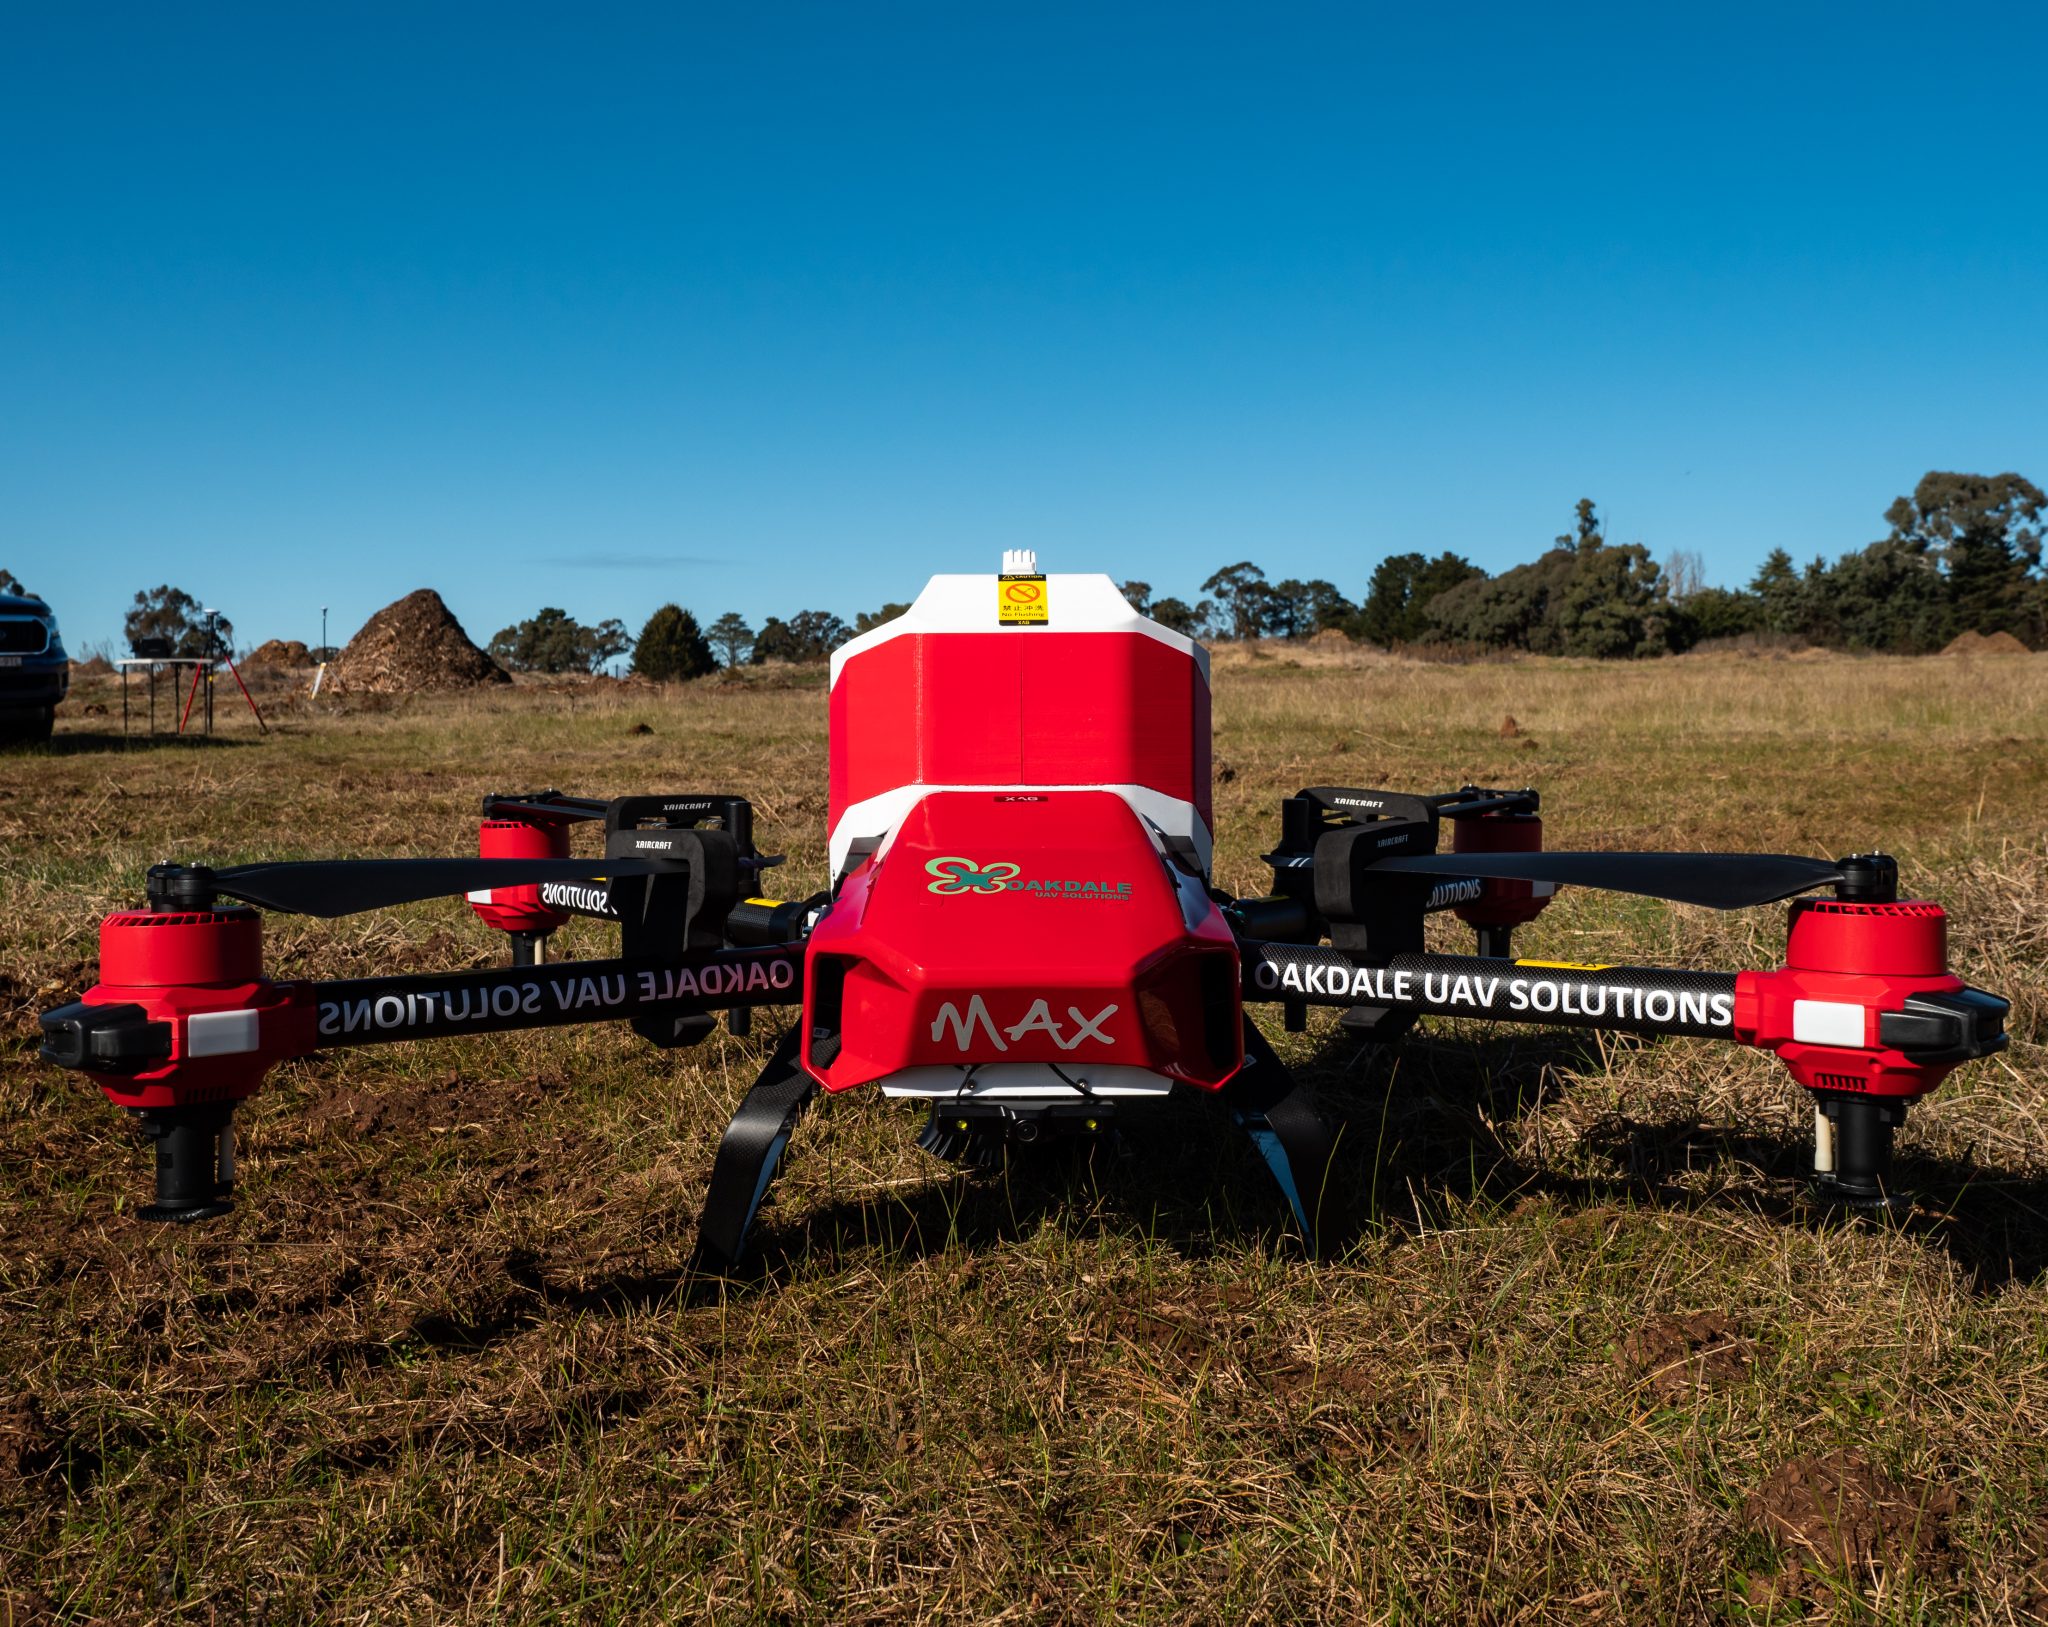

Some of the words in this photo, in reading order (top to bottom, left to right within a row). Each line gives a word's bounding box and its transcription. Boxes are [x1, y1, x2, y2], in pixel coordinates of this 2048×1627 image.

[662, 802, 712, 811] XAIRCRAFT
[1333, 797, 1384, 808] XAIRCRAFT
[635, 840, 672, 850] XAIRCRAFT
[1377, 834, 1409, 848] XAIRCRAFT
[1006, 880, 1132, 894] OAKDALE
[1062, 892, 1129, 900] SOLUTIONS
[1254, 961, 1412, 1000] OAKDALE
[1424, 973, 1499, 1007] UAV
[1509, 978, 1734, 1026] SOLUTIONS
[931, 995, 1119, 1051] MAX
